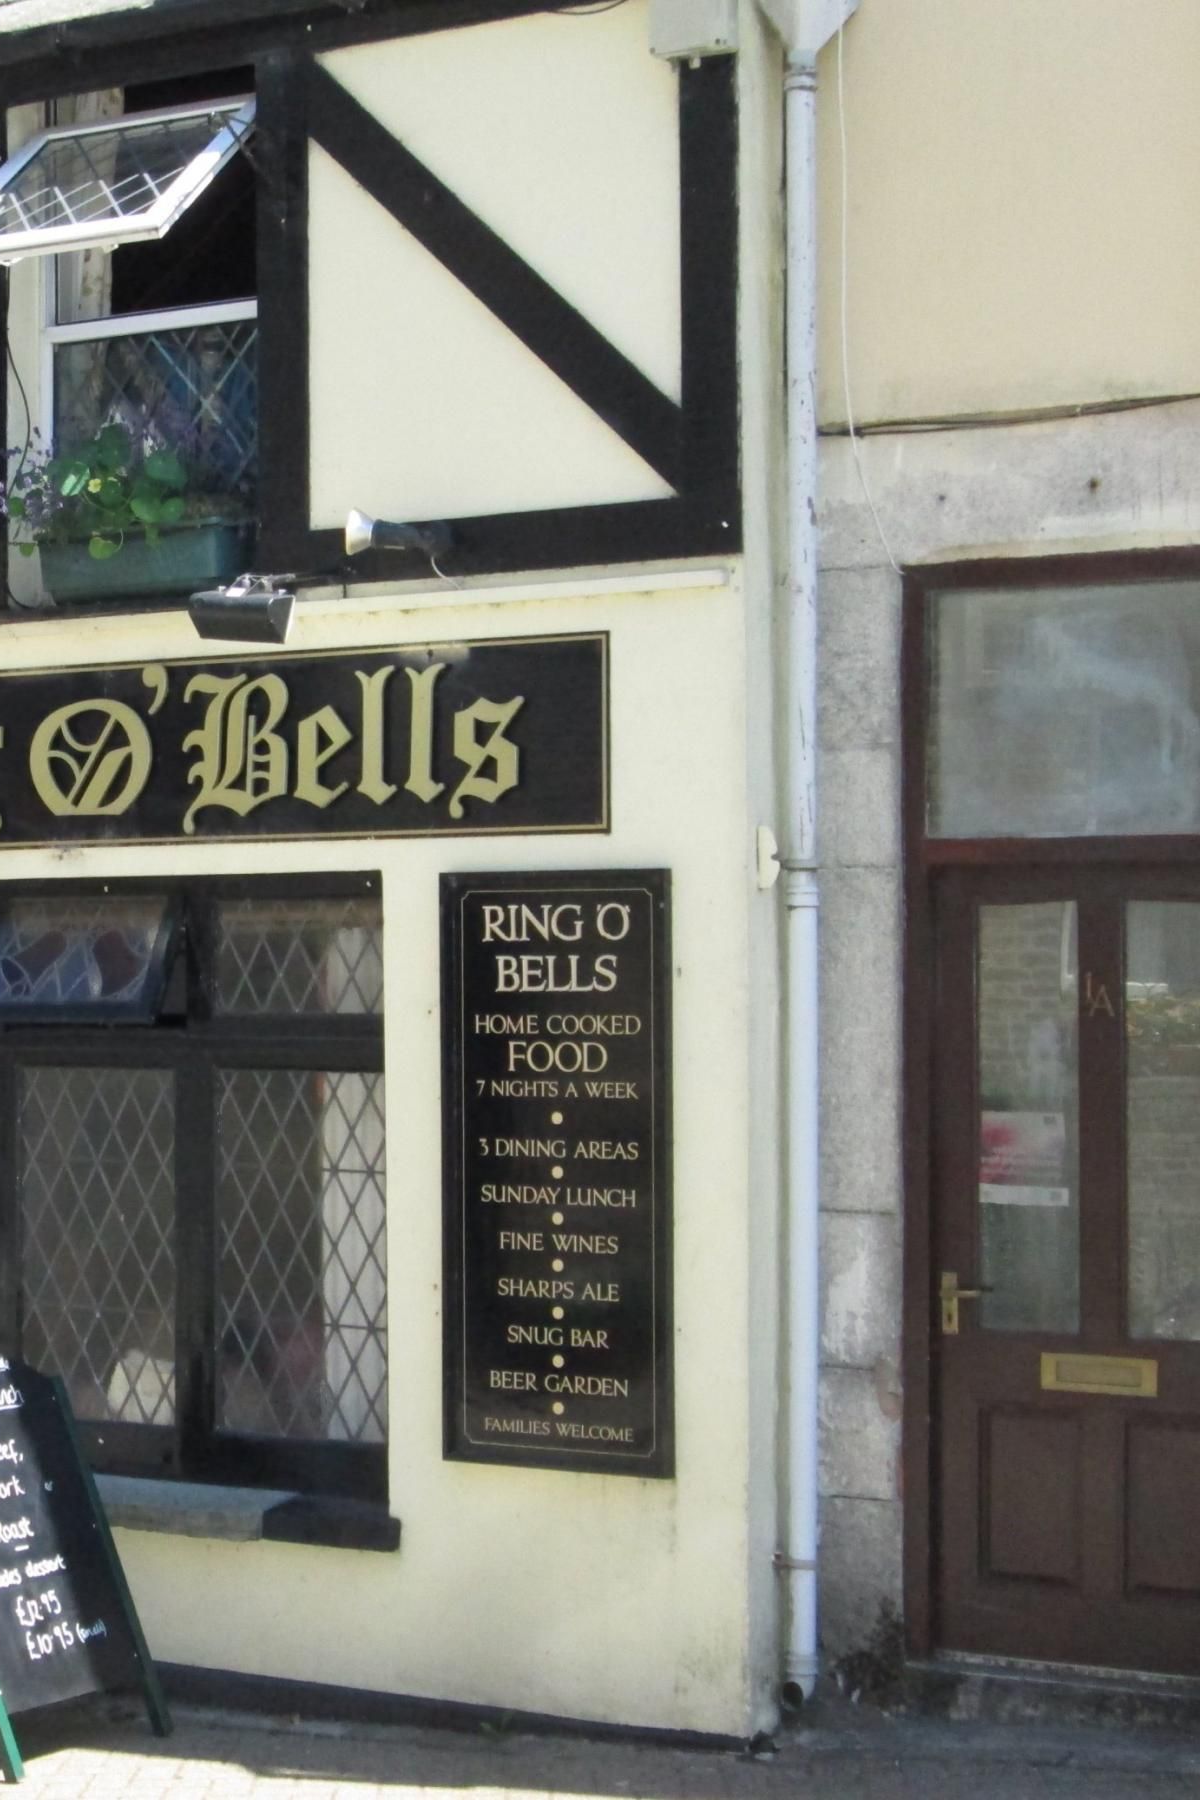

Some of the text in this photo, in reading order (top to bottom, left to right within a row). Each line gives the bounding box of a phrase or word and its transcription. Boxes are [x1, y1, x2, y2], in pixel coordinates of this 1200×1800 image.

[181, 664, 526, 836] Bells
[482, 904, 584, 942] RING
[495, 955, 617, 992] BELLS
[475, 1014, 642, 1036] HOME COOKED
[508, 1041, 608, 1073] FOOD
[476, 1080, 639, 1100] 7 NIGHTS A WEEK
[479, 1138, 639, 1161] 3 DINING AREAS
[480, 1184, 637, 1208] SUNDAY LUNCH
[499, 1231, 619, 1255] FINE WINES
[497, 1278, 620, 1302] SHARPS ALE
[506, 1325, 610, 1349] SNUG BAR
[489, 1370, 629, 1397] BEER GARDEN
[484, 1417, 635, 1442] FAMILIES WELCOME
